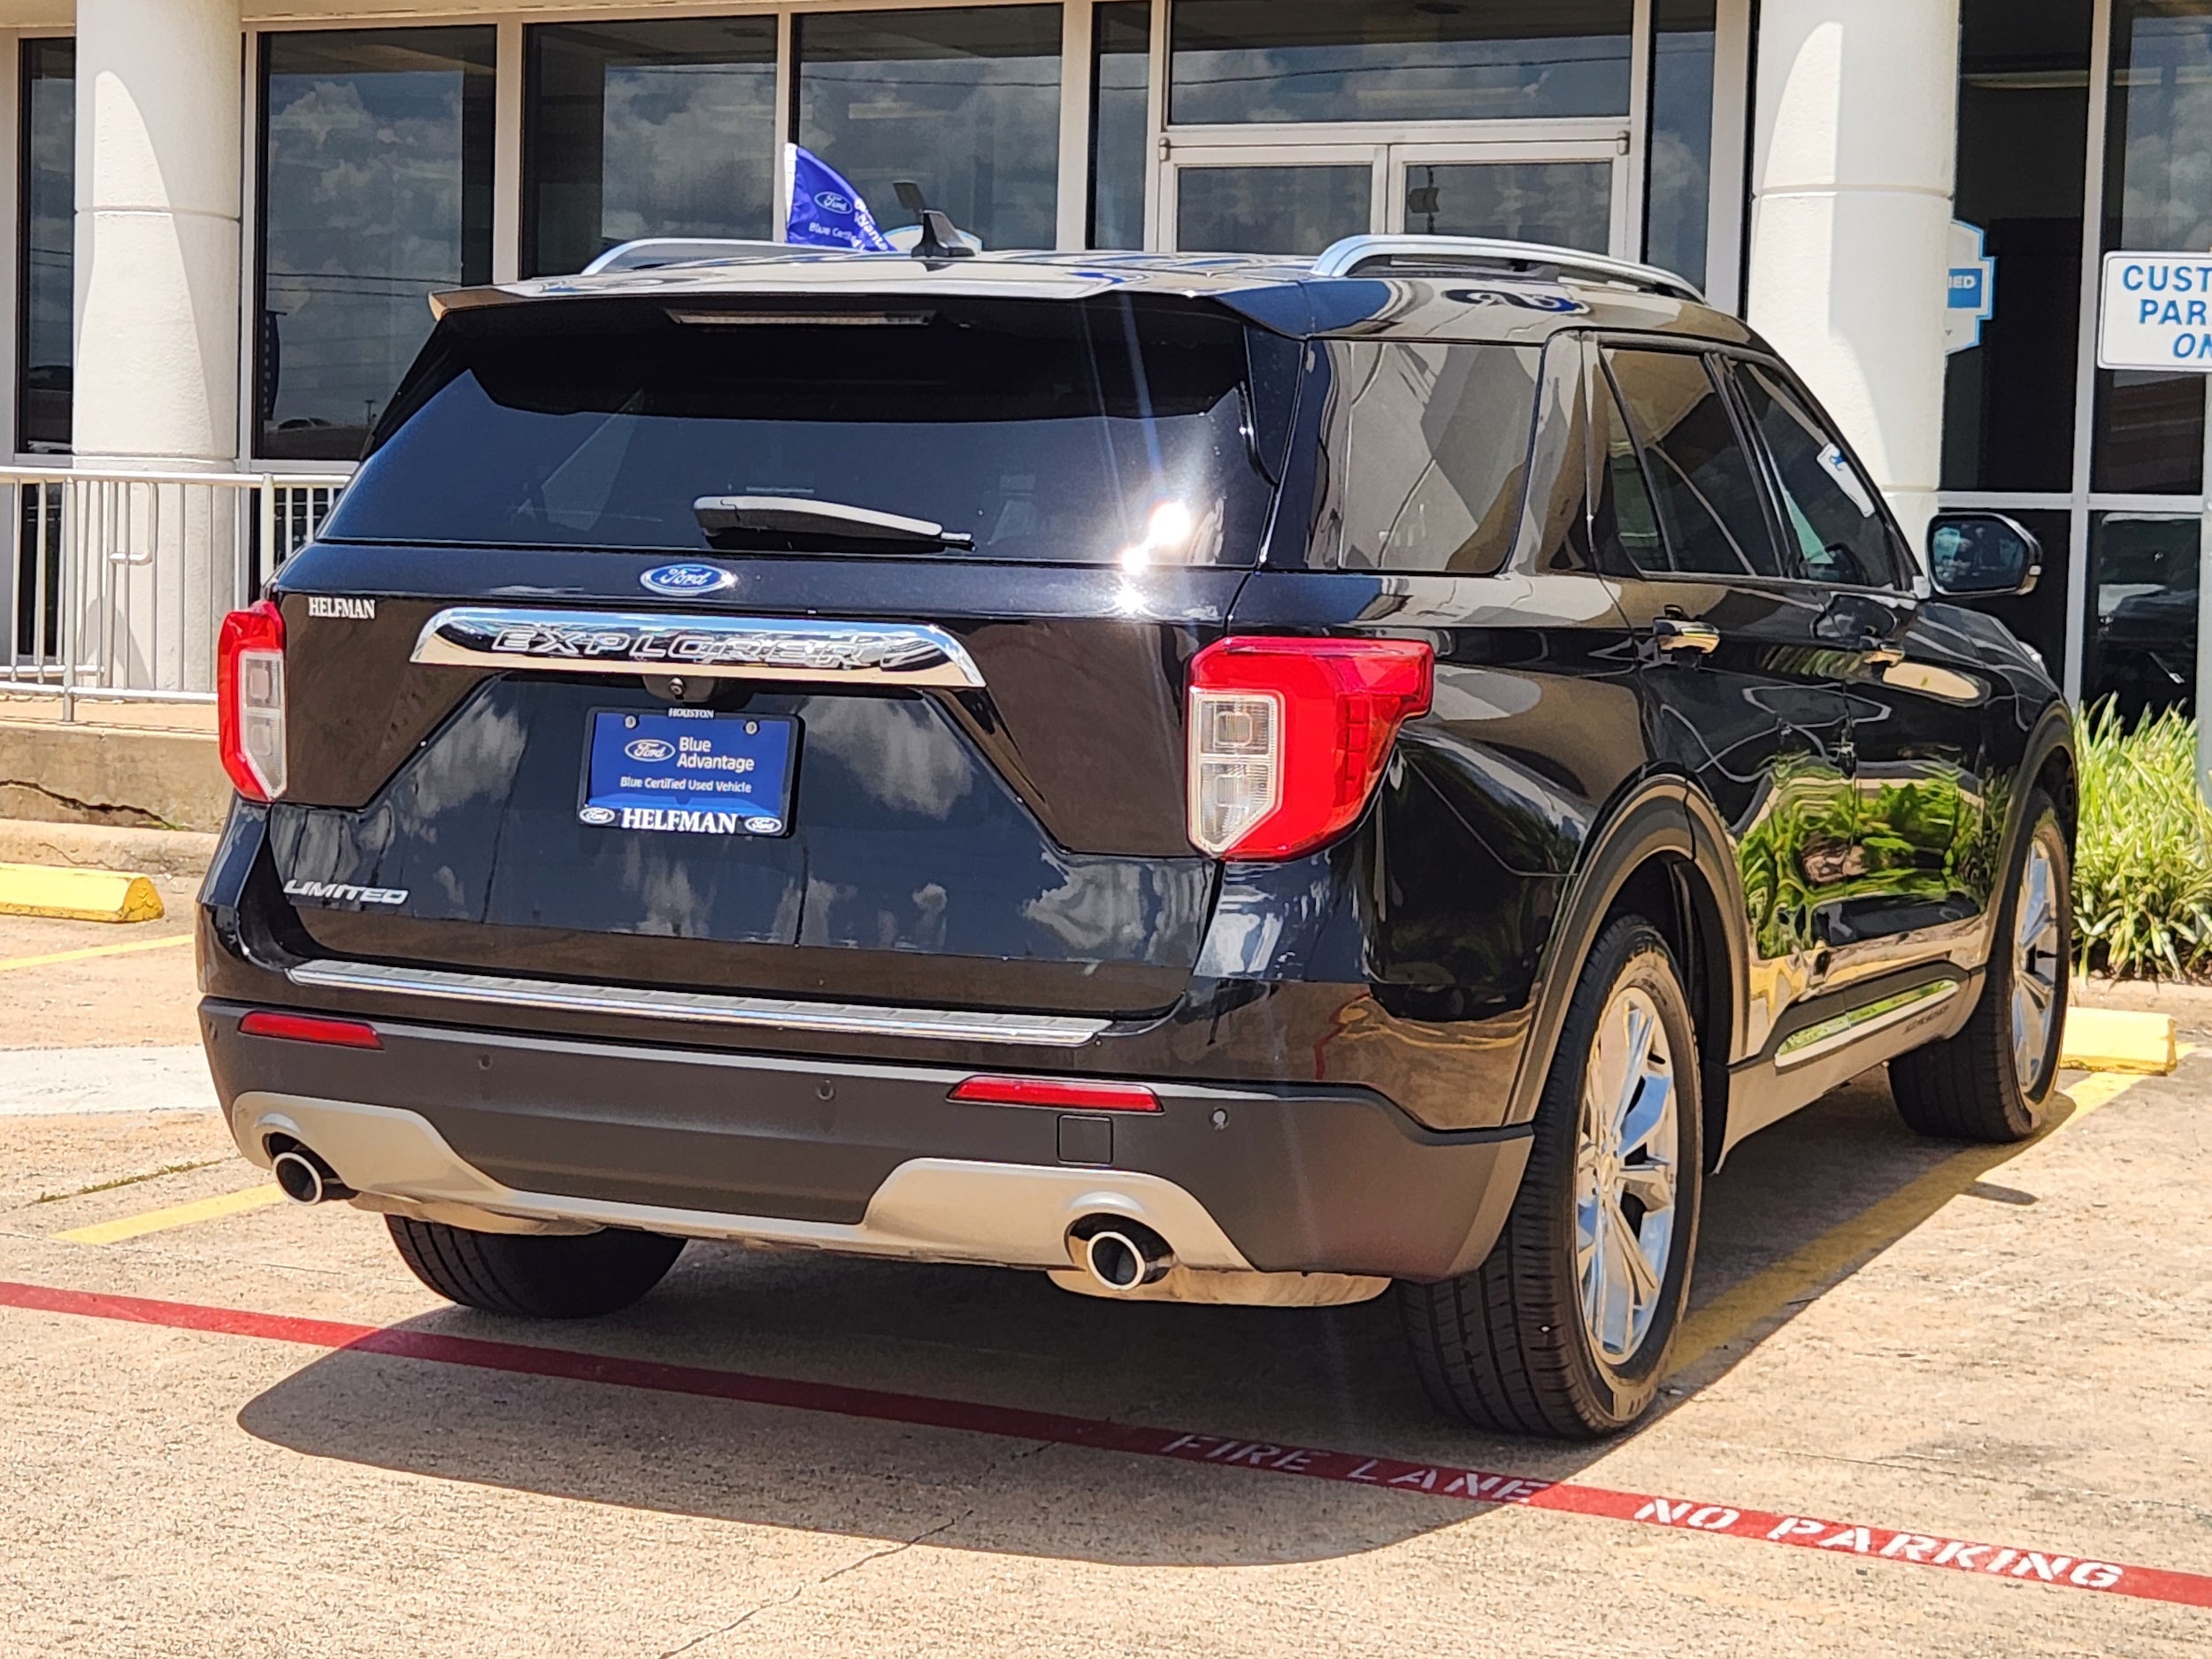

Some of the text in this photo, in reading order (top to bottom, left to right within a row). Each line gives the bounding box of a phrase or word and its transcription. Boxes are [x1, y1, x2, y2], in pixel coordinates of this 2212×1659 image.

[308, 596, 376, 619] HELFMAN
[492, 627, 864, 670] EXPLORER
[668, 708, 714, 718] HOUSTON
[680, 737, 711, 752] Blue
[677, 754, 755, 773] Advantage
[620, 777, 752, 793] Blue Certified Used Vehicle
[622, 807, 738, 834] HELFMAN
[283, 879, 410, 904] LIMITED
[1161, 1434, 2124, 1589] FIRE LANE NO PARKING
